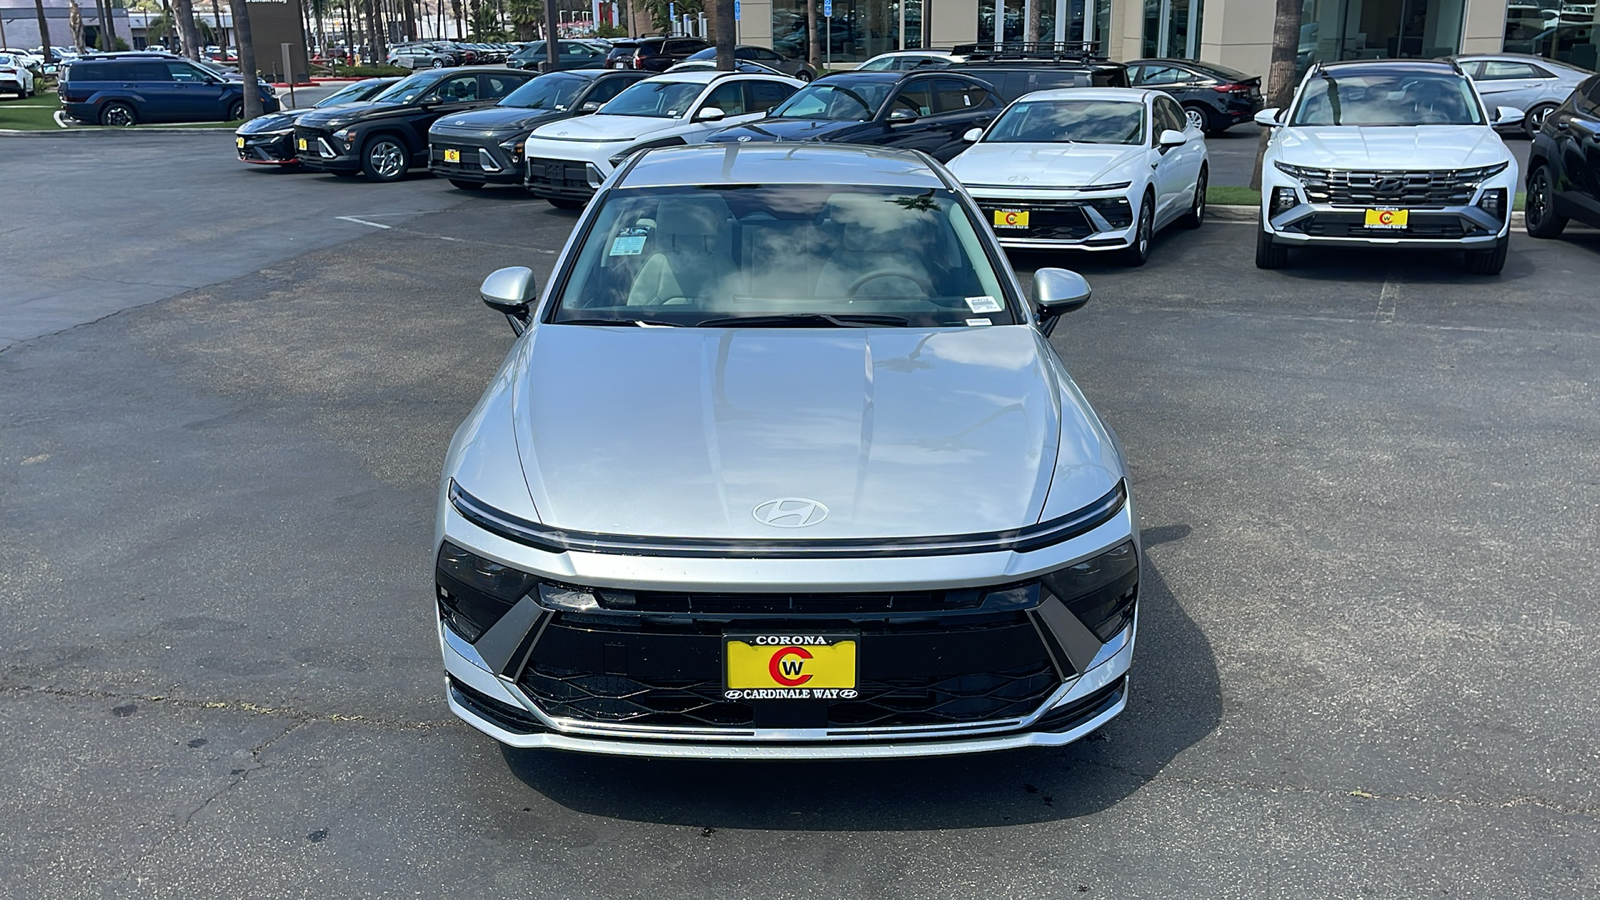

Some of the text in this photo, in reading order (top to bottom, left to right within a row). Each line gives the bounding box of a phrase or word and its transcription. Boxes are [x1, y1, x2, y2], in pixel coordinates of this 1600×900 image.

[756, 635, 826, 645] CORONA
[743, 689, 839, 699] CARDINALE WAY
